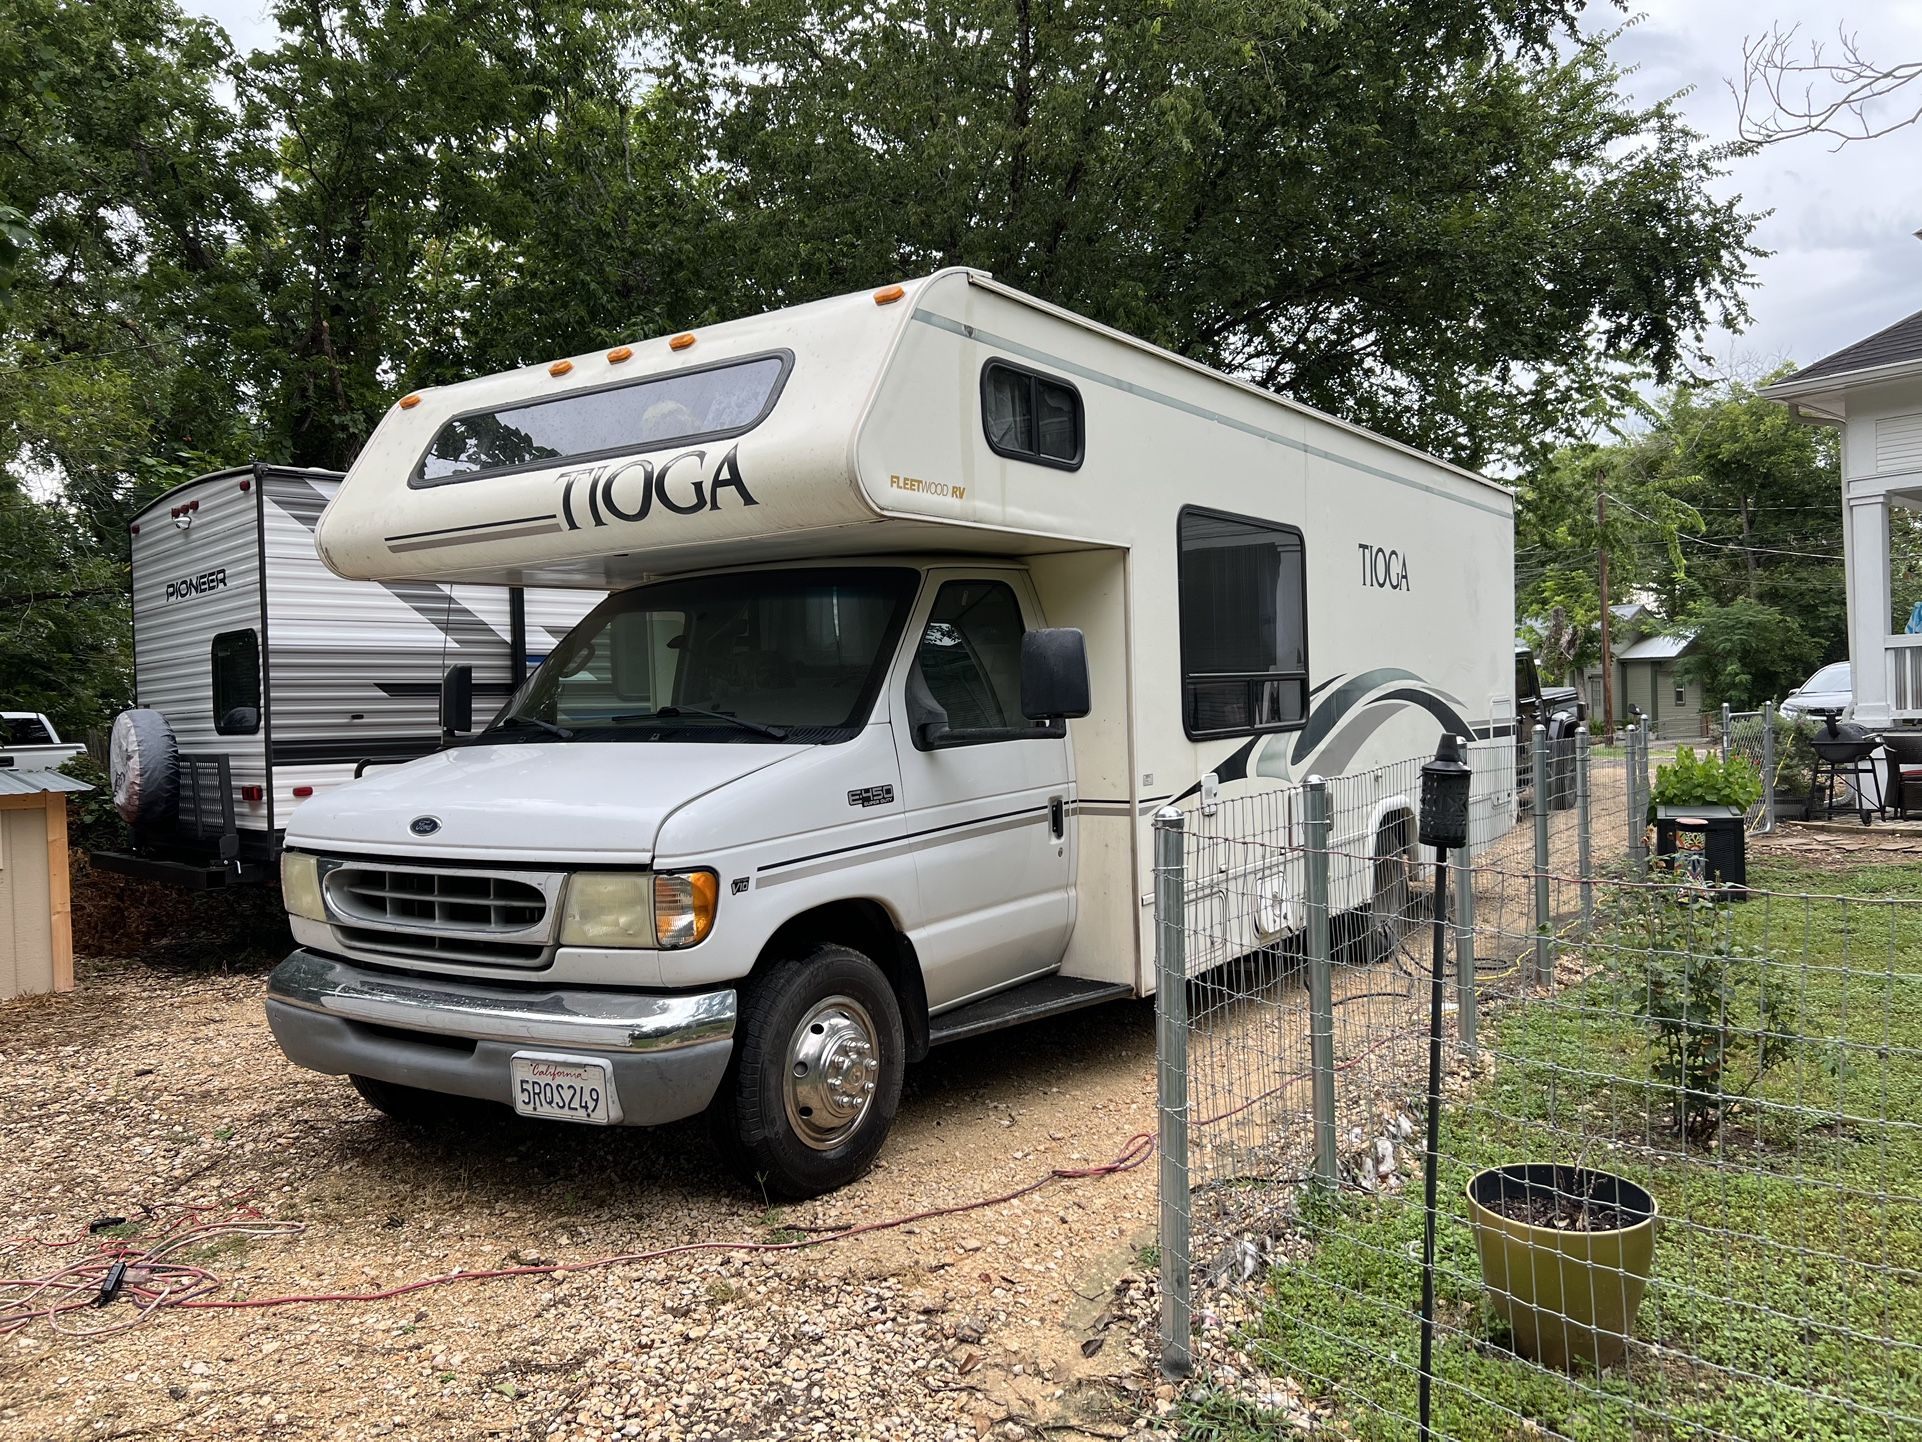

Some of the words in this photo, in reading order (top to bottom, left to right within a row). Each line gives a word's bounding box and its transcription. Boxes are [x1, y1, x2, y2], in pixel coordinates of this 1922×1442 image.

[554, 442, 760, 531] TIOGA
[890, 474, 949, 497] FLEETWOOD
[951, 486, 966, 499] RV
[1358, 543, 1411, 592] TIOGA
[166, 568, 228, 602] PIONEER
[731, 881, 749, 895] V10
[531, 1063, 588, 1081] California
[520, 1079, 600, 1114] 5RQS249
